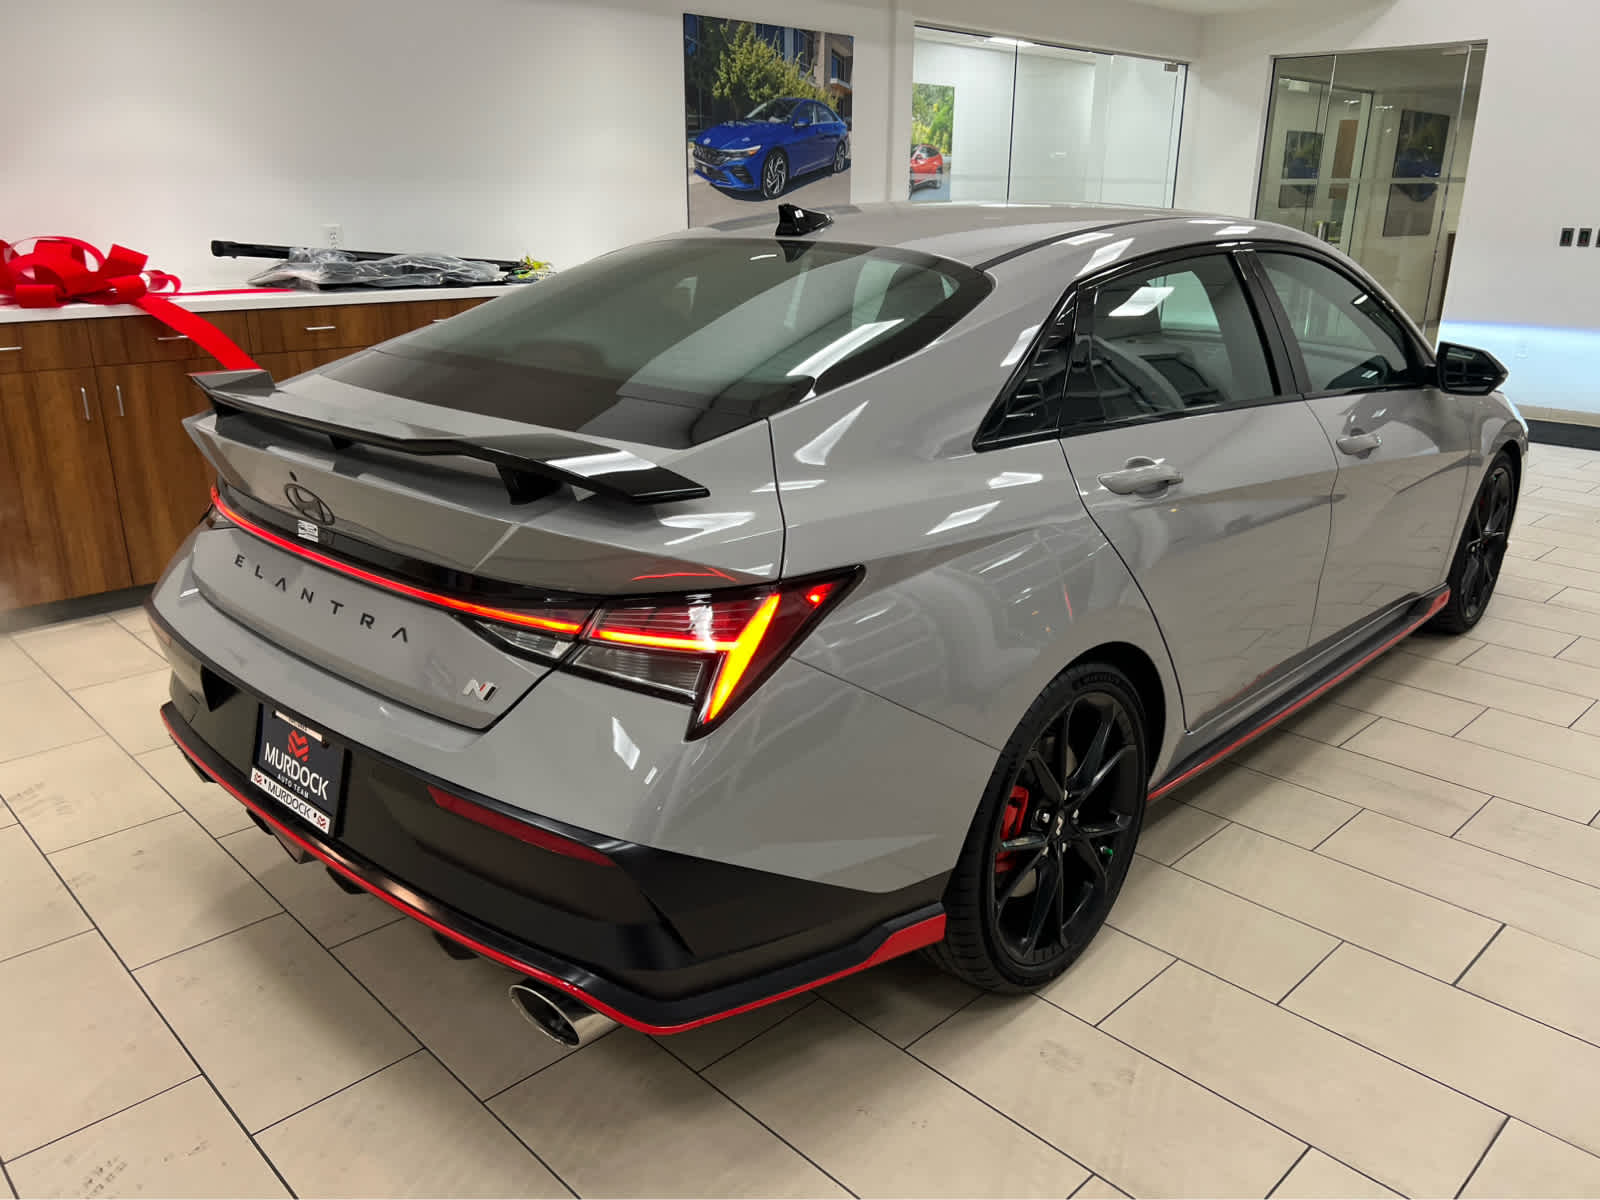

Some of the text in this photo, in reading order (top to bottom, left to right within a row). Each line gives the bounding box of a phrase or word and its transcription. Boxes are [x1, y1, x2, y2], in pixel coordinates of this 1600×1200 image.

[233, 553, 409, 643] ELANTRA
[264, 742, 329, 801] MURDOCK
[277, 773, 309, 799] AUTO TEAM
[267, 781, 312, 818] MURDOCK
